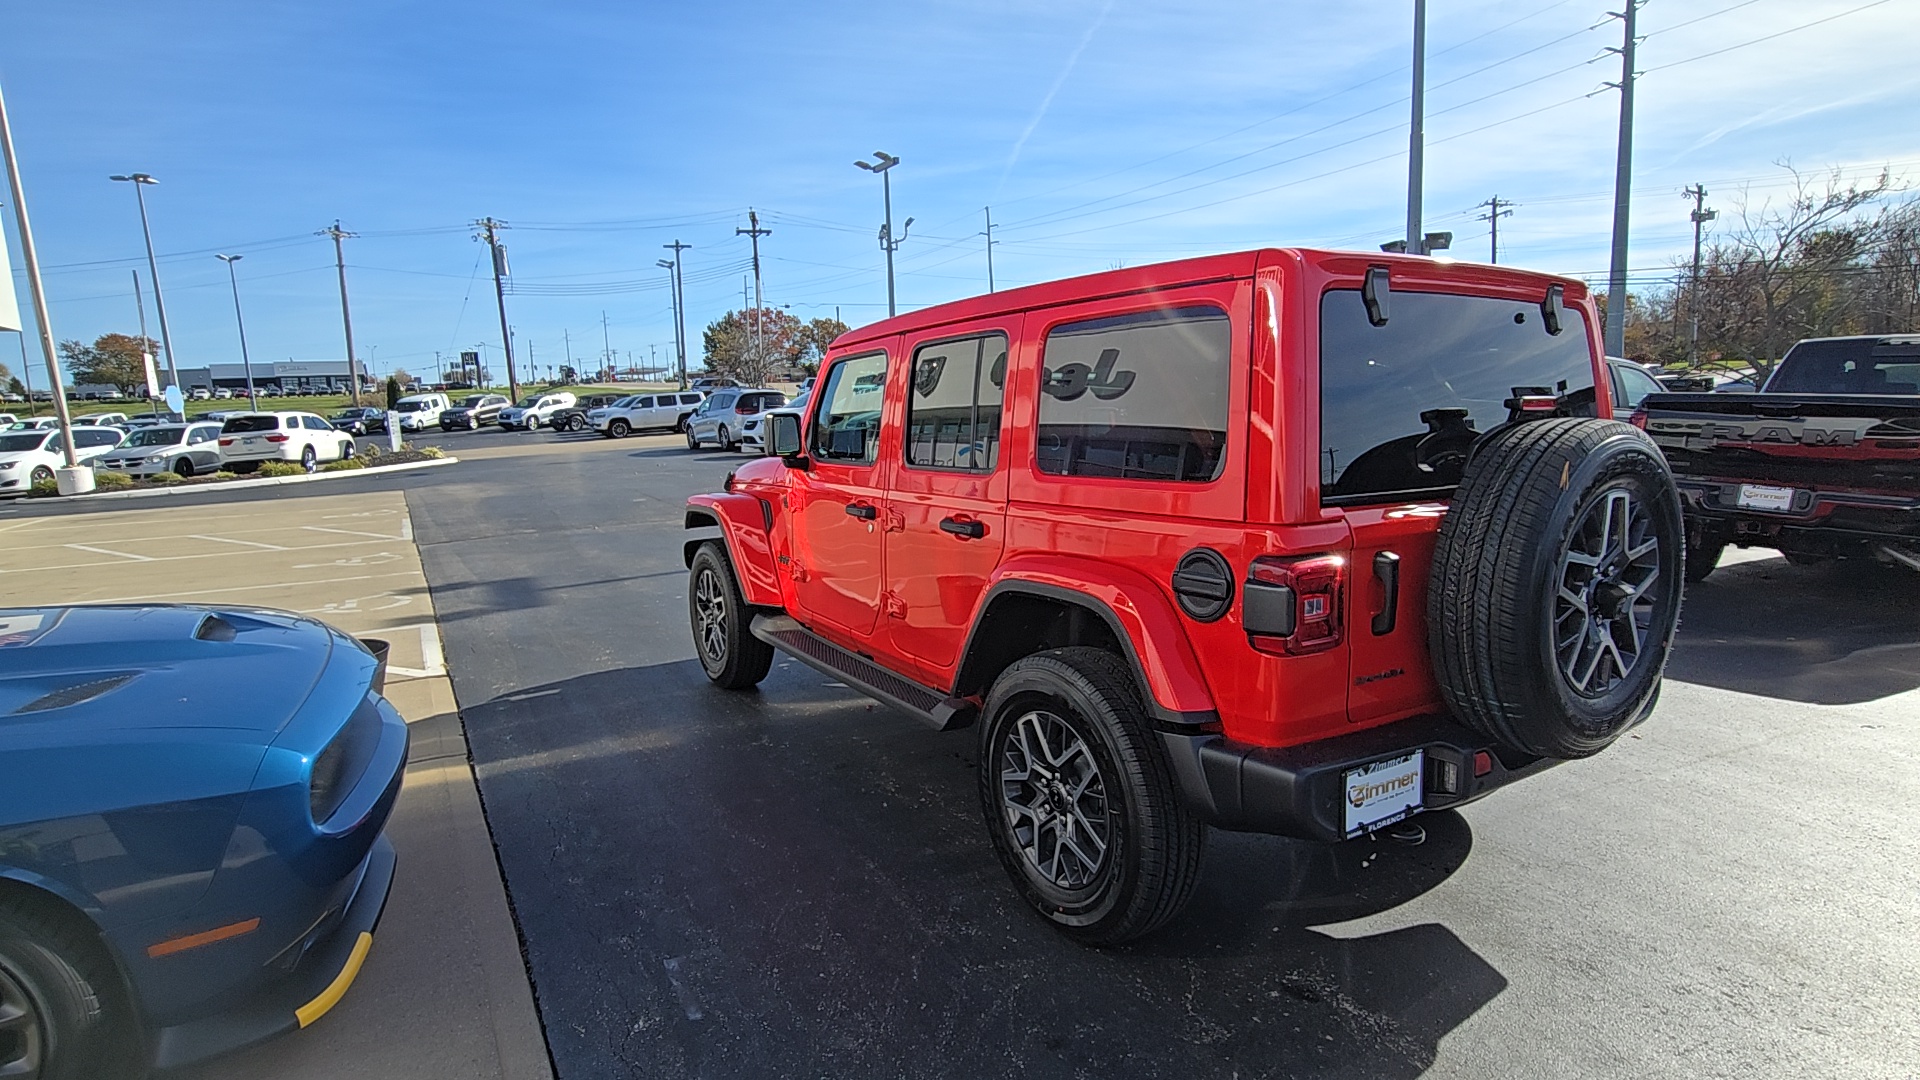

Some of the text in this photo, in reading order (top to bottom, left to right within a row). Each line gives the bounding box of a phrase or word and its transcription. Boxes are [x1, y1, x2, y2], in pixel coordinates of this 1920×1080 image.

[1700, 427, 1857, 446] RAM
[1367, 756, 1406, 775] Zimmer
[1349, 770, 1419, 806] Zimmer
[1368, 813, 1406, 832] FLORENCE
